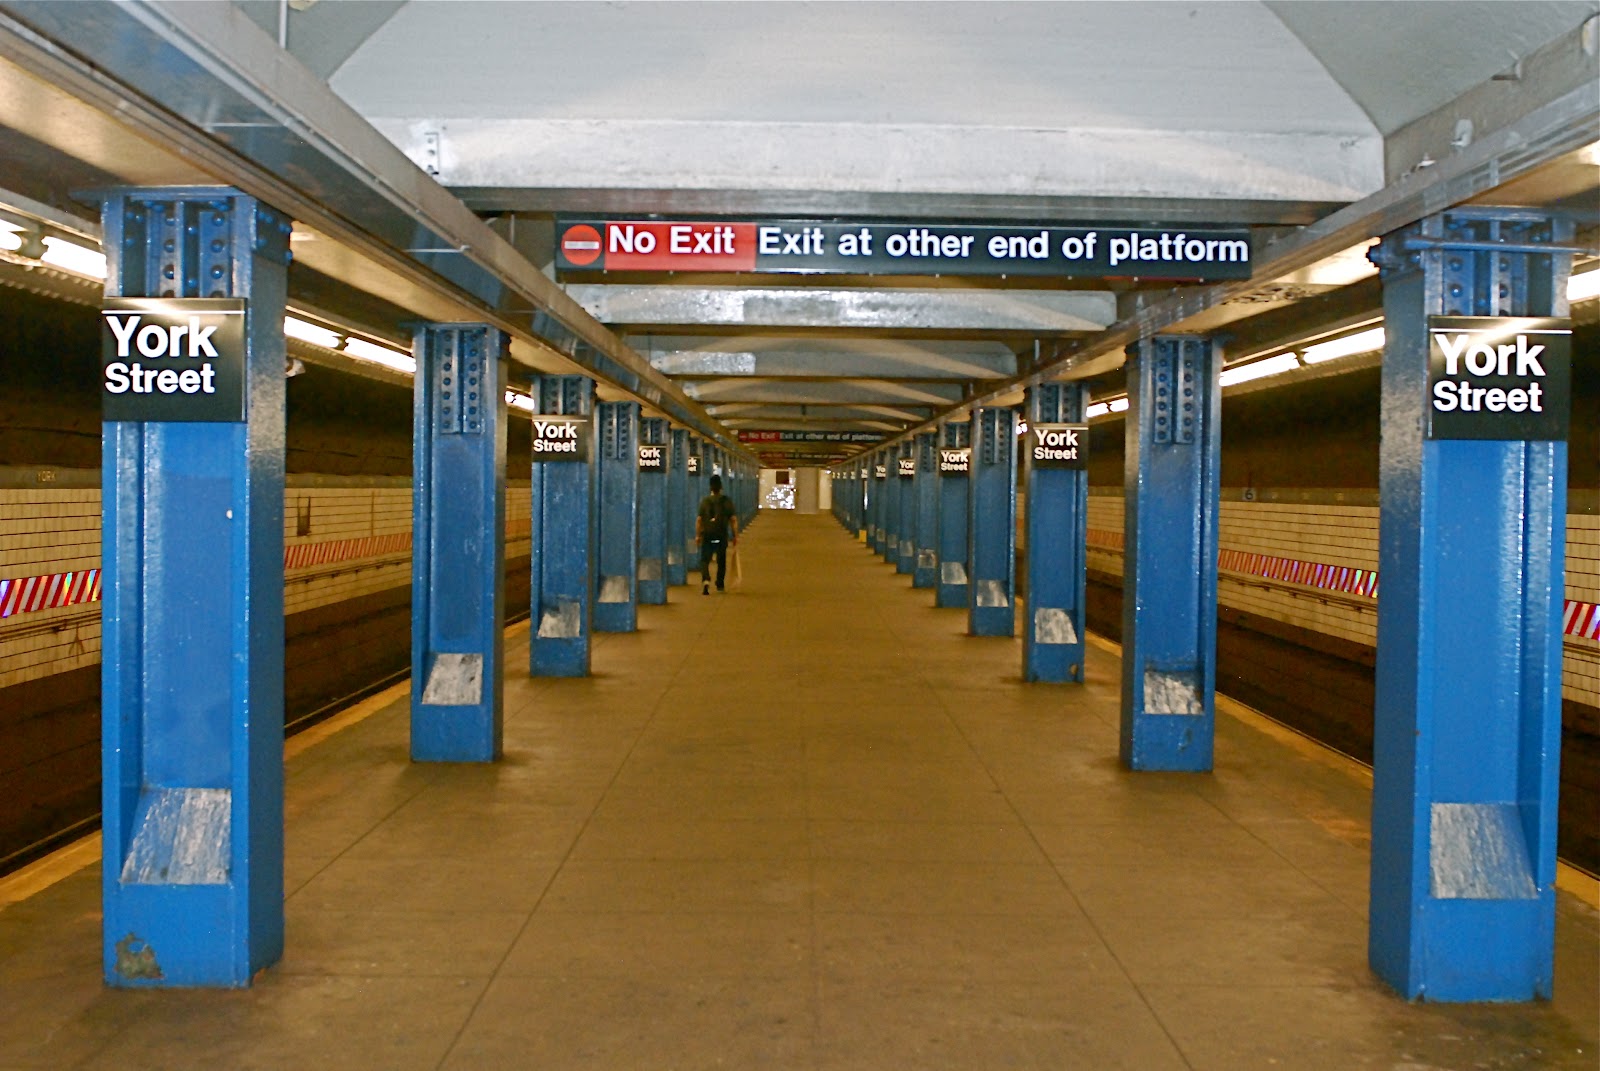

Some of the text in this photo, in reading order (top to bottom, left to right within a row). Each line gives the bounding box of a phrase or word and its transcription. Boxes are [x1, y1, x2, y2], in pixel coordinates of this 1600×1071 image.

[609, 225, 735, 254] No Exit
[759, 227, 1249, 265] Exit at other end of platform
[105, 315, 218, 358] York
[1434, 334, 1546, 377] York
[105, 363, 215, 393] Street
[1433, 381, 1543, 412] Street
[533, 422, 577, 438] York
[1034, 429, 1079, 446] York
[533, 440, 577, 452] Street
[639, 447, 660, 458] ork
[1034, 447, 1077, 460] Street
[640, 458, 660, 466] treet
[899, 460, 915, 469] Yor
[941, 451, 968, 463] York
[941, 462, 968, 471] Street
